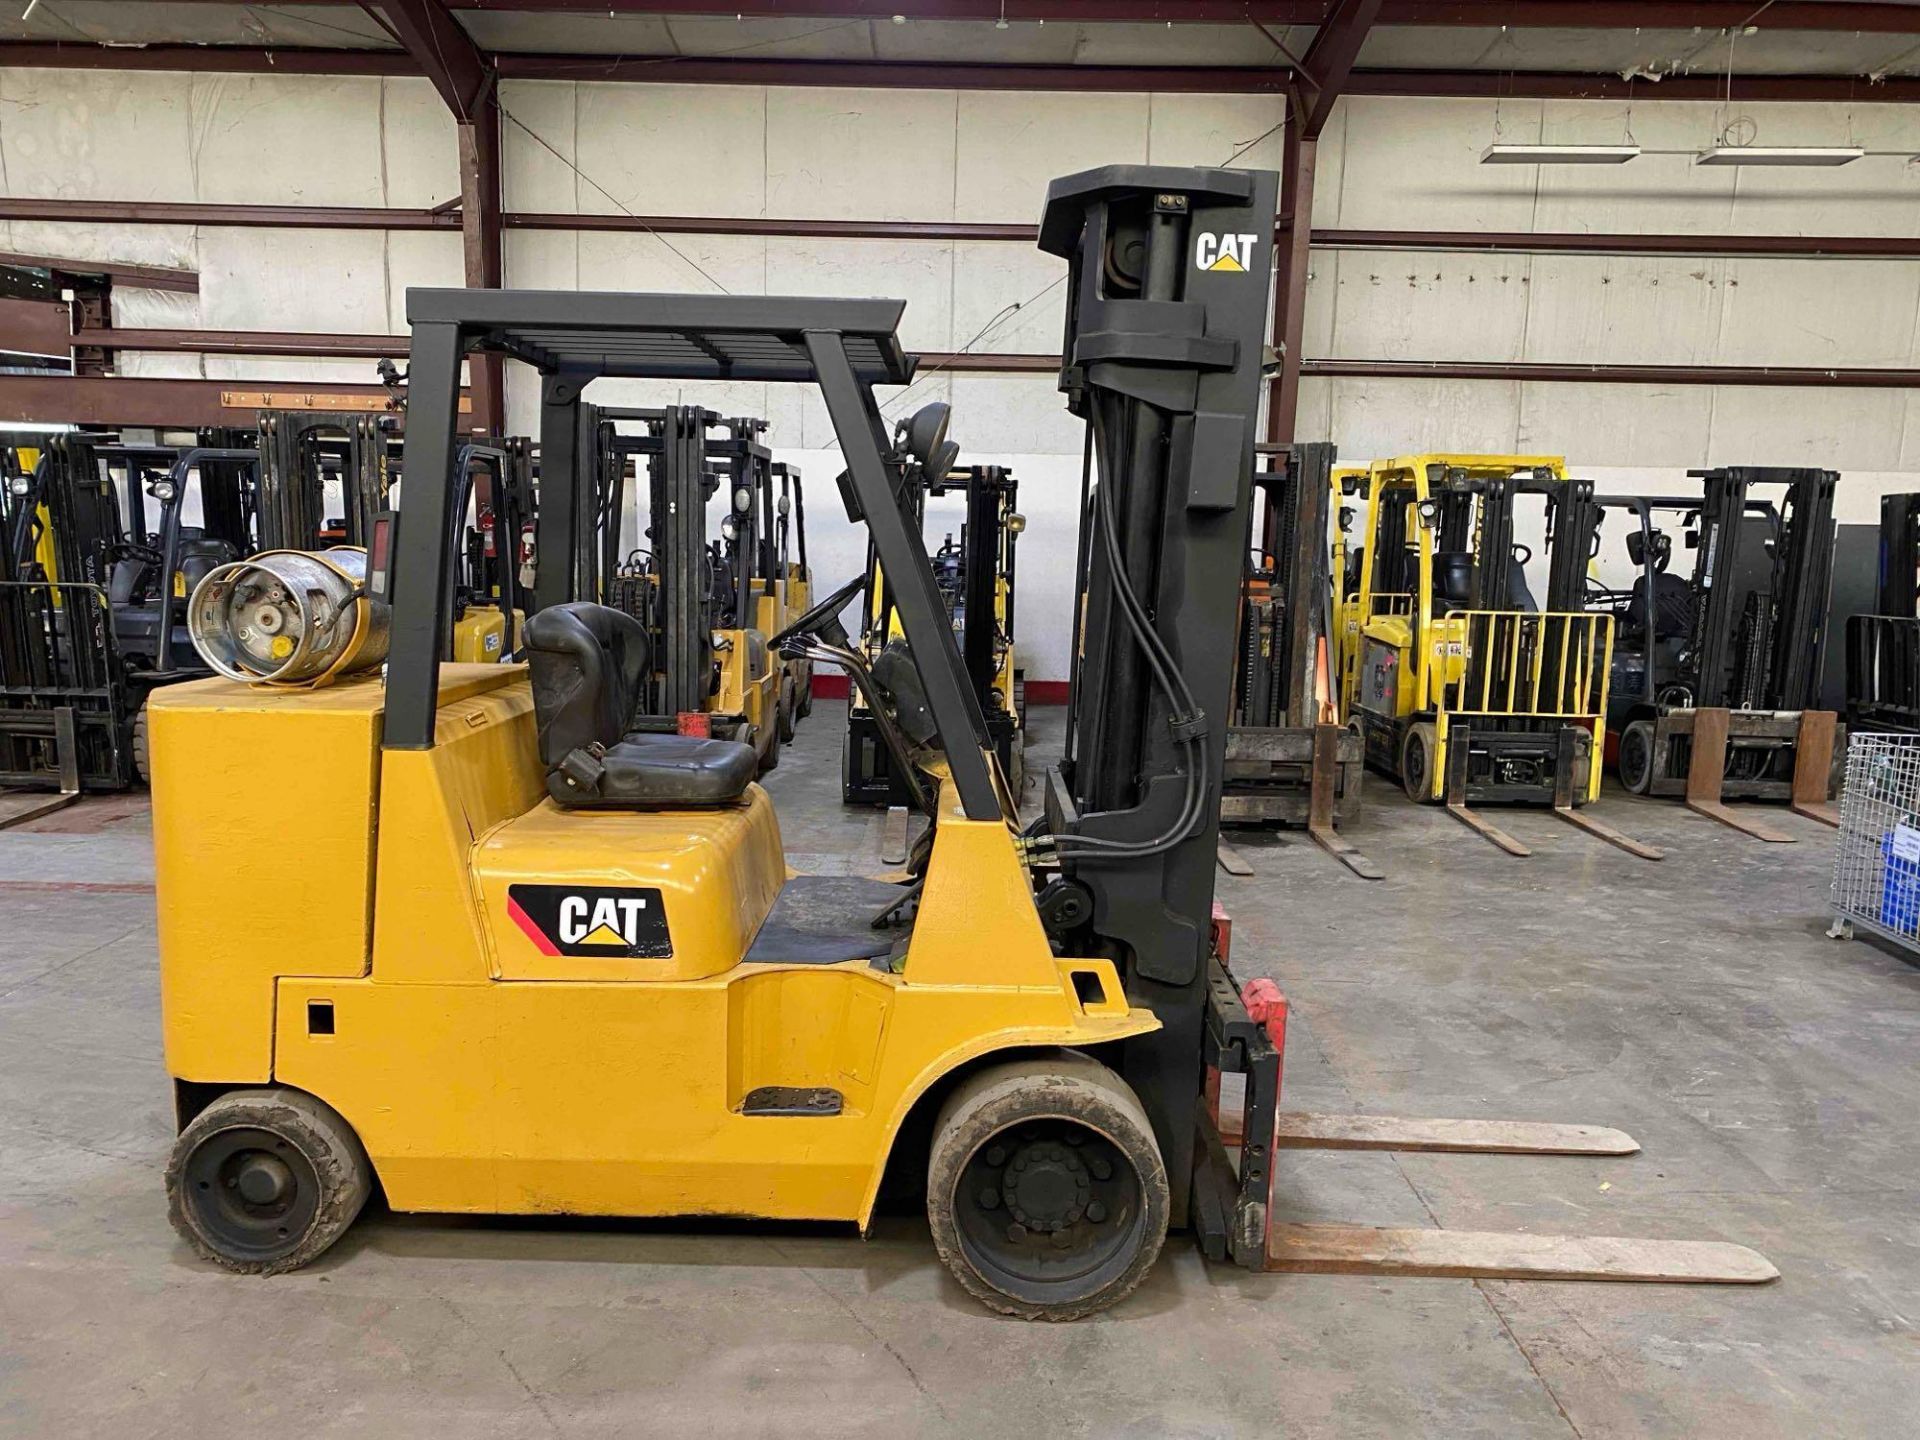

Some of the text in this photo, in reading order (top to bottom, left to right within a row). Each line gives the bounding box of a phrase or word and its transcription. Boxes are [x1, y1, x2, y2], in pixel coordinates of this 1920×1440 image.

[1196, 232, 1258, 272] CAT
[380, 454, 388, 500] Yale
[559, 896, 646, 945] CAT
